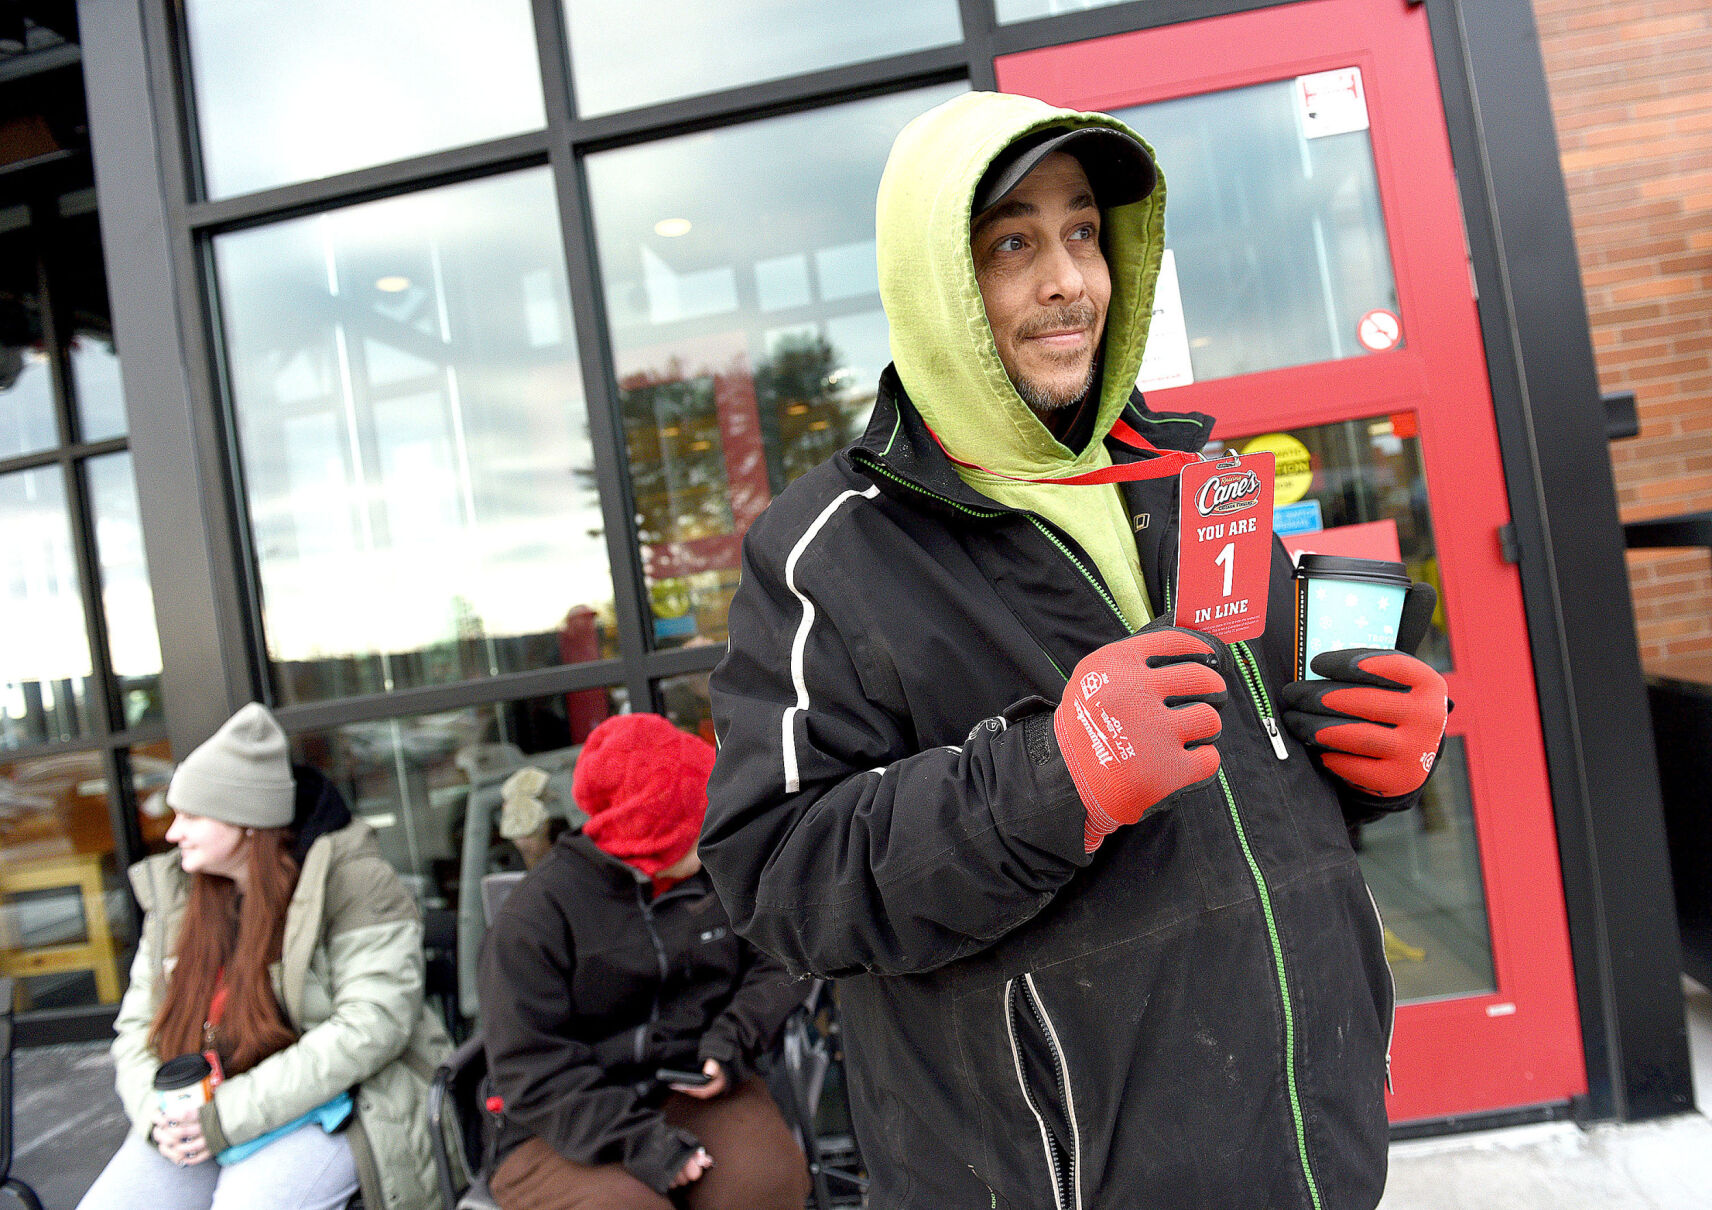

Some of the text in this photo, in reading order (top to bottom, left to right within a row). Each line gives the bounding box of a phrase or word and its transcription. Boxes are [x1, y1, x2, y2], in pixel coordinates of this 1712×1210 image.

[1198, 470, 1260, 515] Cane's
[1196, 524, 1225, 543] YOU
[1229, 517, 1257, 539] ARE
[1214, 542, 1235, 598] 1
[1194, 599, 1249, 624] IN LINE
[1073, 697, 1114, 770] Milwaukee
[1100, 707, 1119, 740] LEVEL
[1115, 740, 1129, 761] CUT
[1124, 742, 1137, 758] XL
